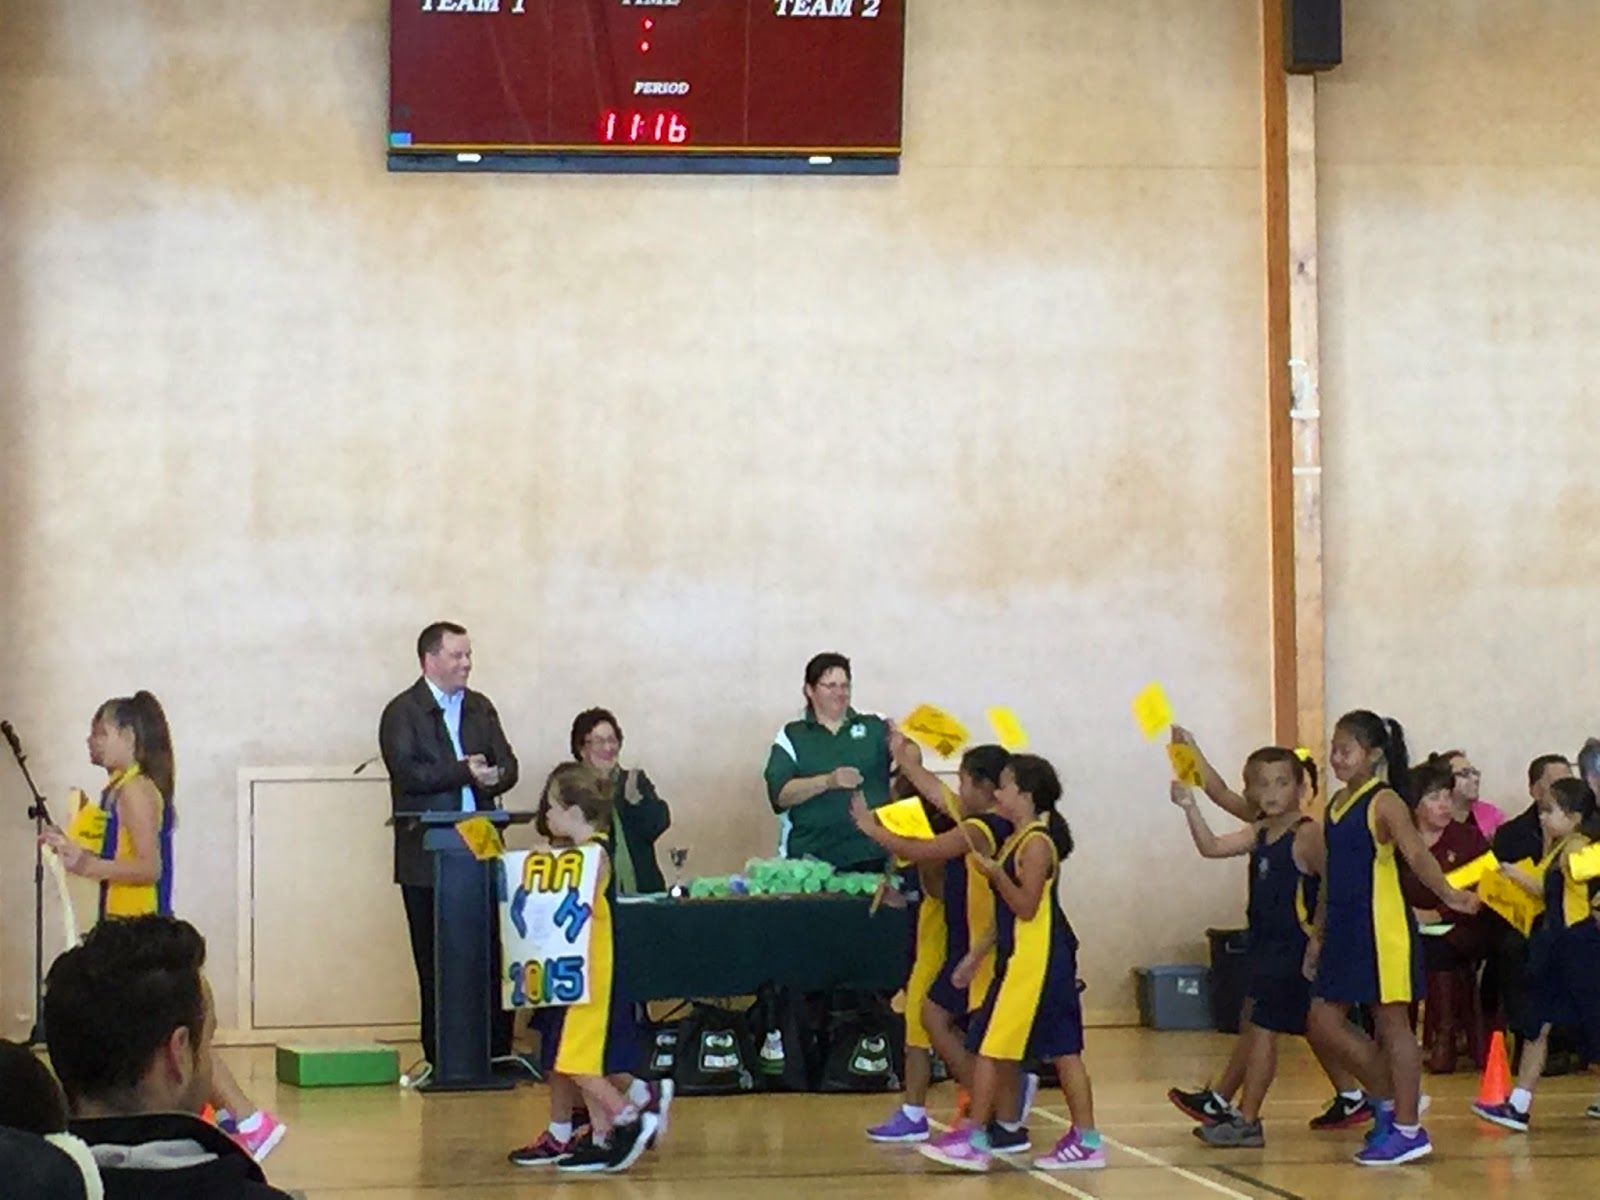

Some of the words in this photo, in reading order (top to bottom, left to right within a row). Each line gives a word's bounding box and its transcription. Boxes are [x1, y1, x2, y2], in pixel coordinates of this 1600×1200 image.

[774, 0, 853, 17] TEAM
[860, 0, 881, 17] 2
[633, 81, 690, 95] PERIOD
